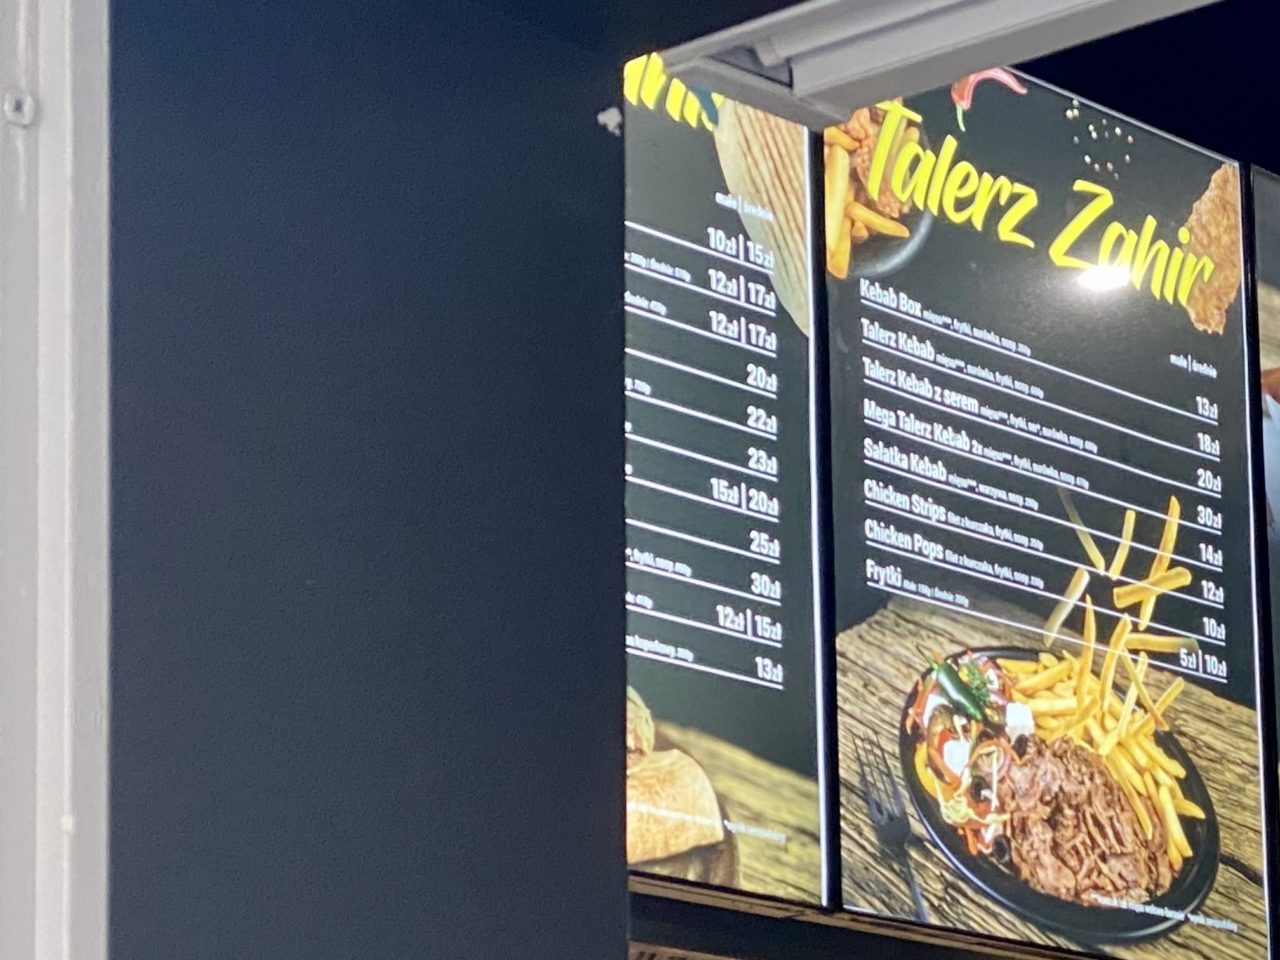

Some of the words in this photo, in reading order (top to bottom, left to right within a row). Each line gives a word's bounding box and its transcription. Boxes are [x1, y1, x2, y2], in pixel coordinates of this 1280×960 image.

[867, 99, 1038, 249] Talerz
[1048, 179, 1215, 307] Zahir
[860, 278, 897, 308] Kebab
[899, 292, 921, 317] Box
[860, 317, 897, 348] Talerz
[898, 331, 935, 361] Kebab
[862, 356, 896, 386] Talerz
[897, 369, 933, 399] Kebab
[934, 386, 942, 402] z
[943, 388, 979, 415] serem
[863, 398, 895, 427] Mega
[897, 410, 932, 439] Talerz
[933, 422, 970, 452] Kebab
[910, 452, 947, 482] Kebab
[863, 478, 910, 512] Chicken
[911, 493, 946, 523] Strips
[864, 518, 912, 551] Chicken
[913, 533, 943, 560] Pops
[865, 558, 902, 586] Frytki
